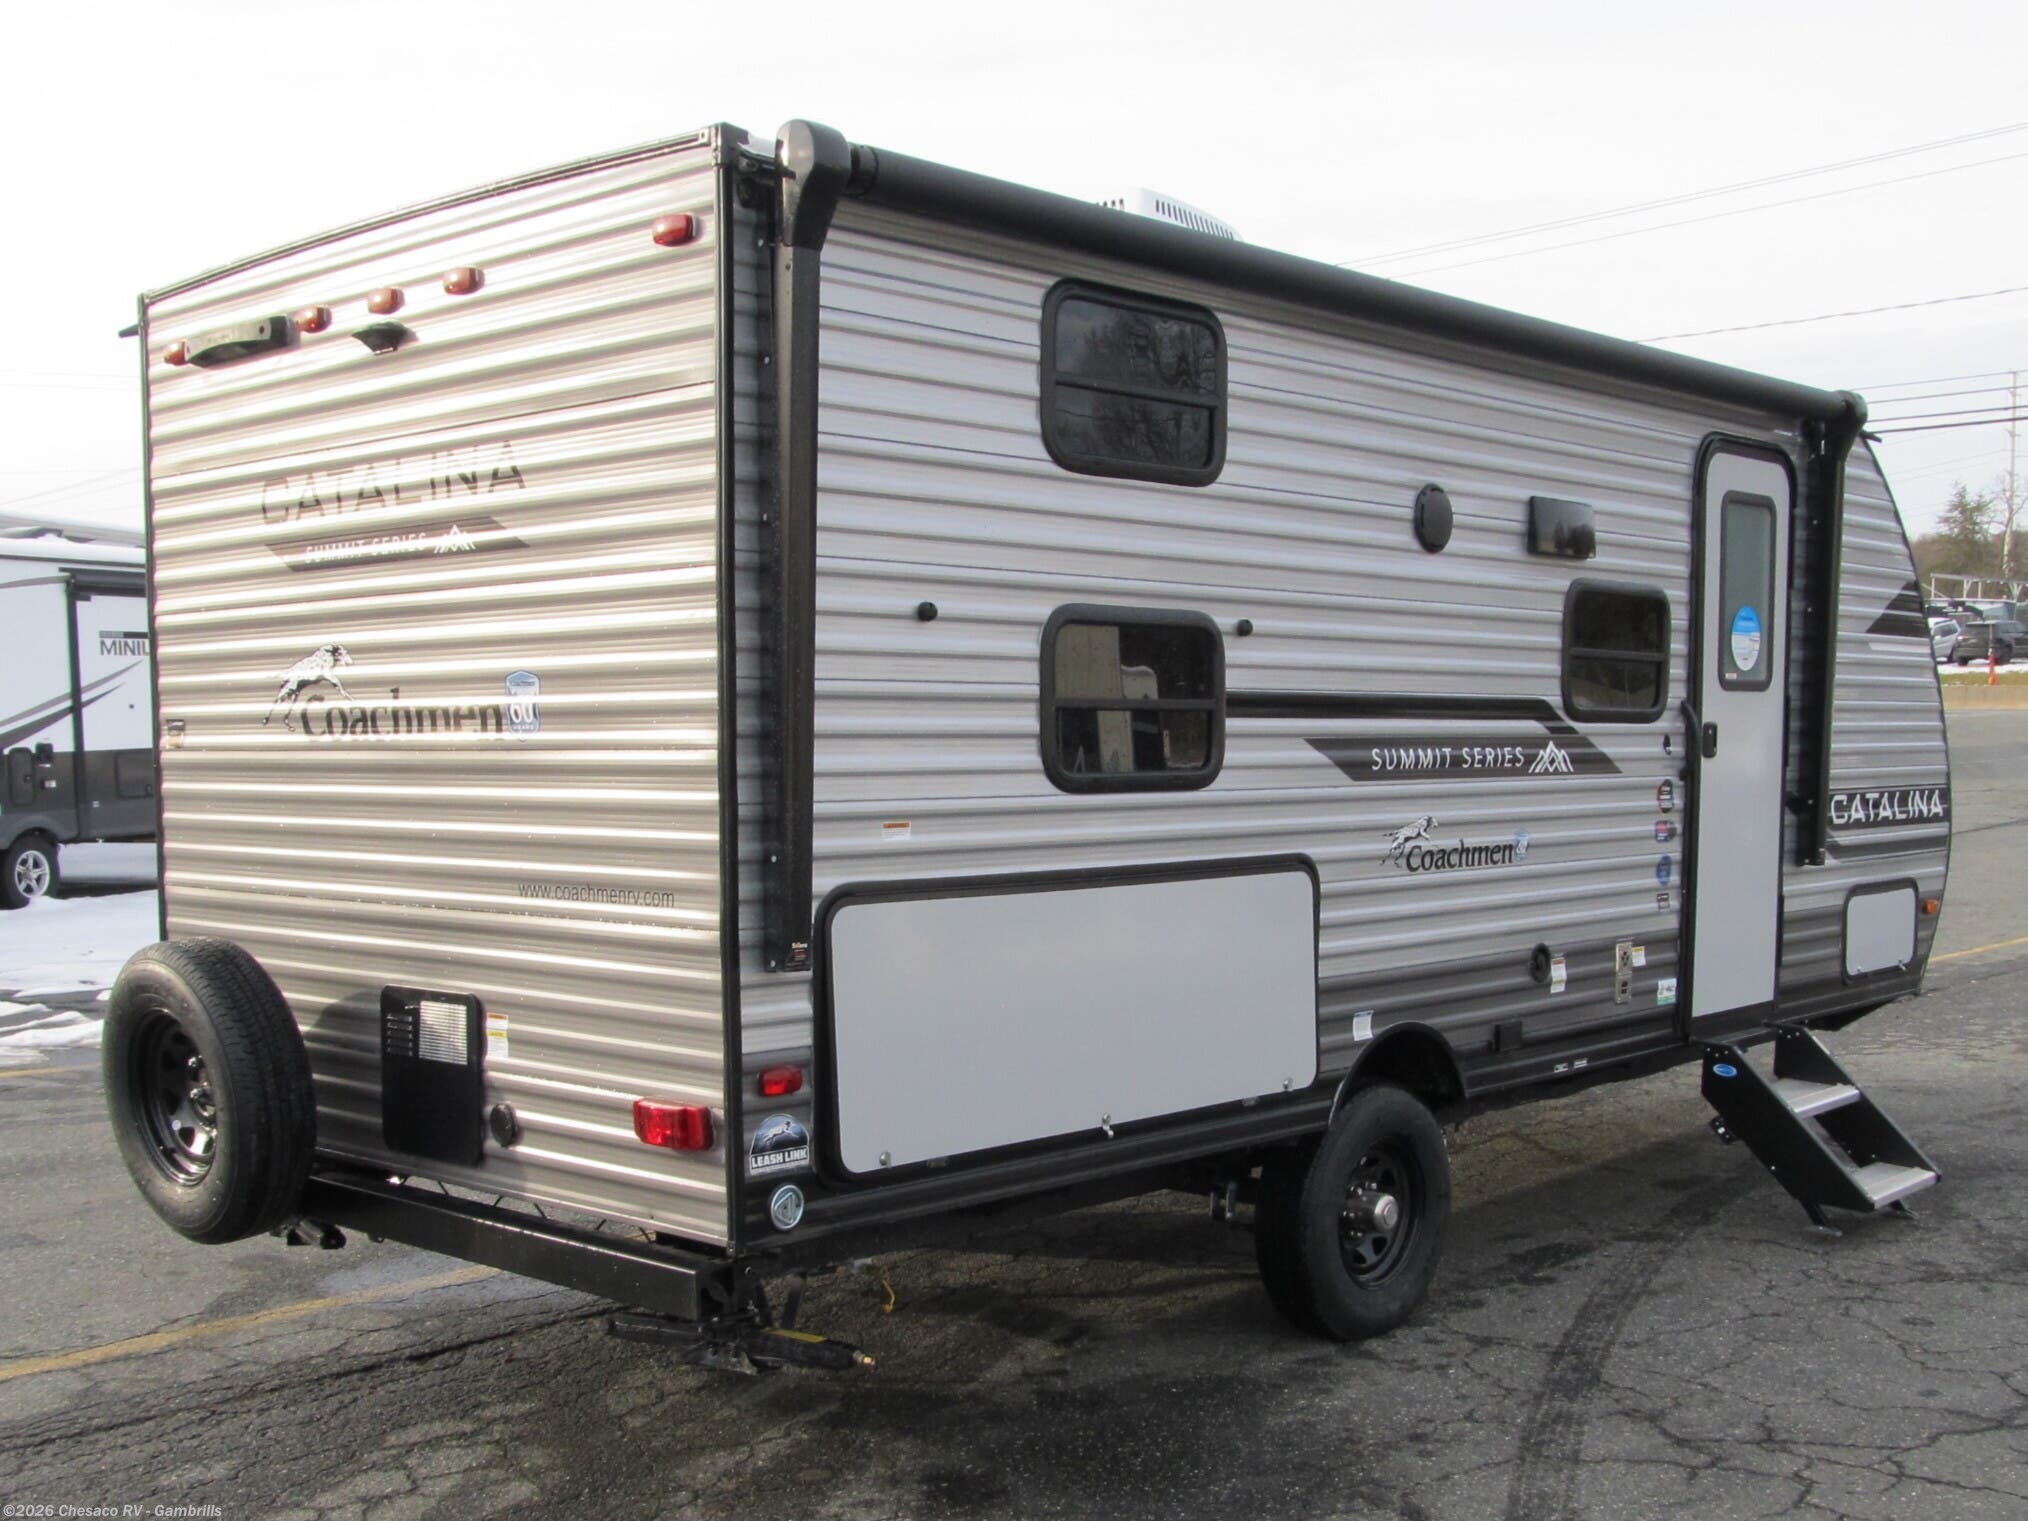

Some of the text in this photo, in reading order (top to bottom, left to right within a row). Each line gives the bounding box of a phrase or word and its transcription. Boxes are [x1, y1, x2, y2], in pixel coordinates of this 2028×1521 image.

[261, 439, 526, 525] CATALINA
[301, 687, 504, 740] Coachmen
[1371, 746, 1525, 770] SUMMIT SERIES
[1830, 789, 1944, 825] CATALINA
[1406, 838, 1514, 872] Coachmen
[518, 882, 675, 908] www.coachmenrv.com
[751, 1148, 808, 1169] LEASH LINK
